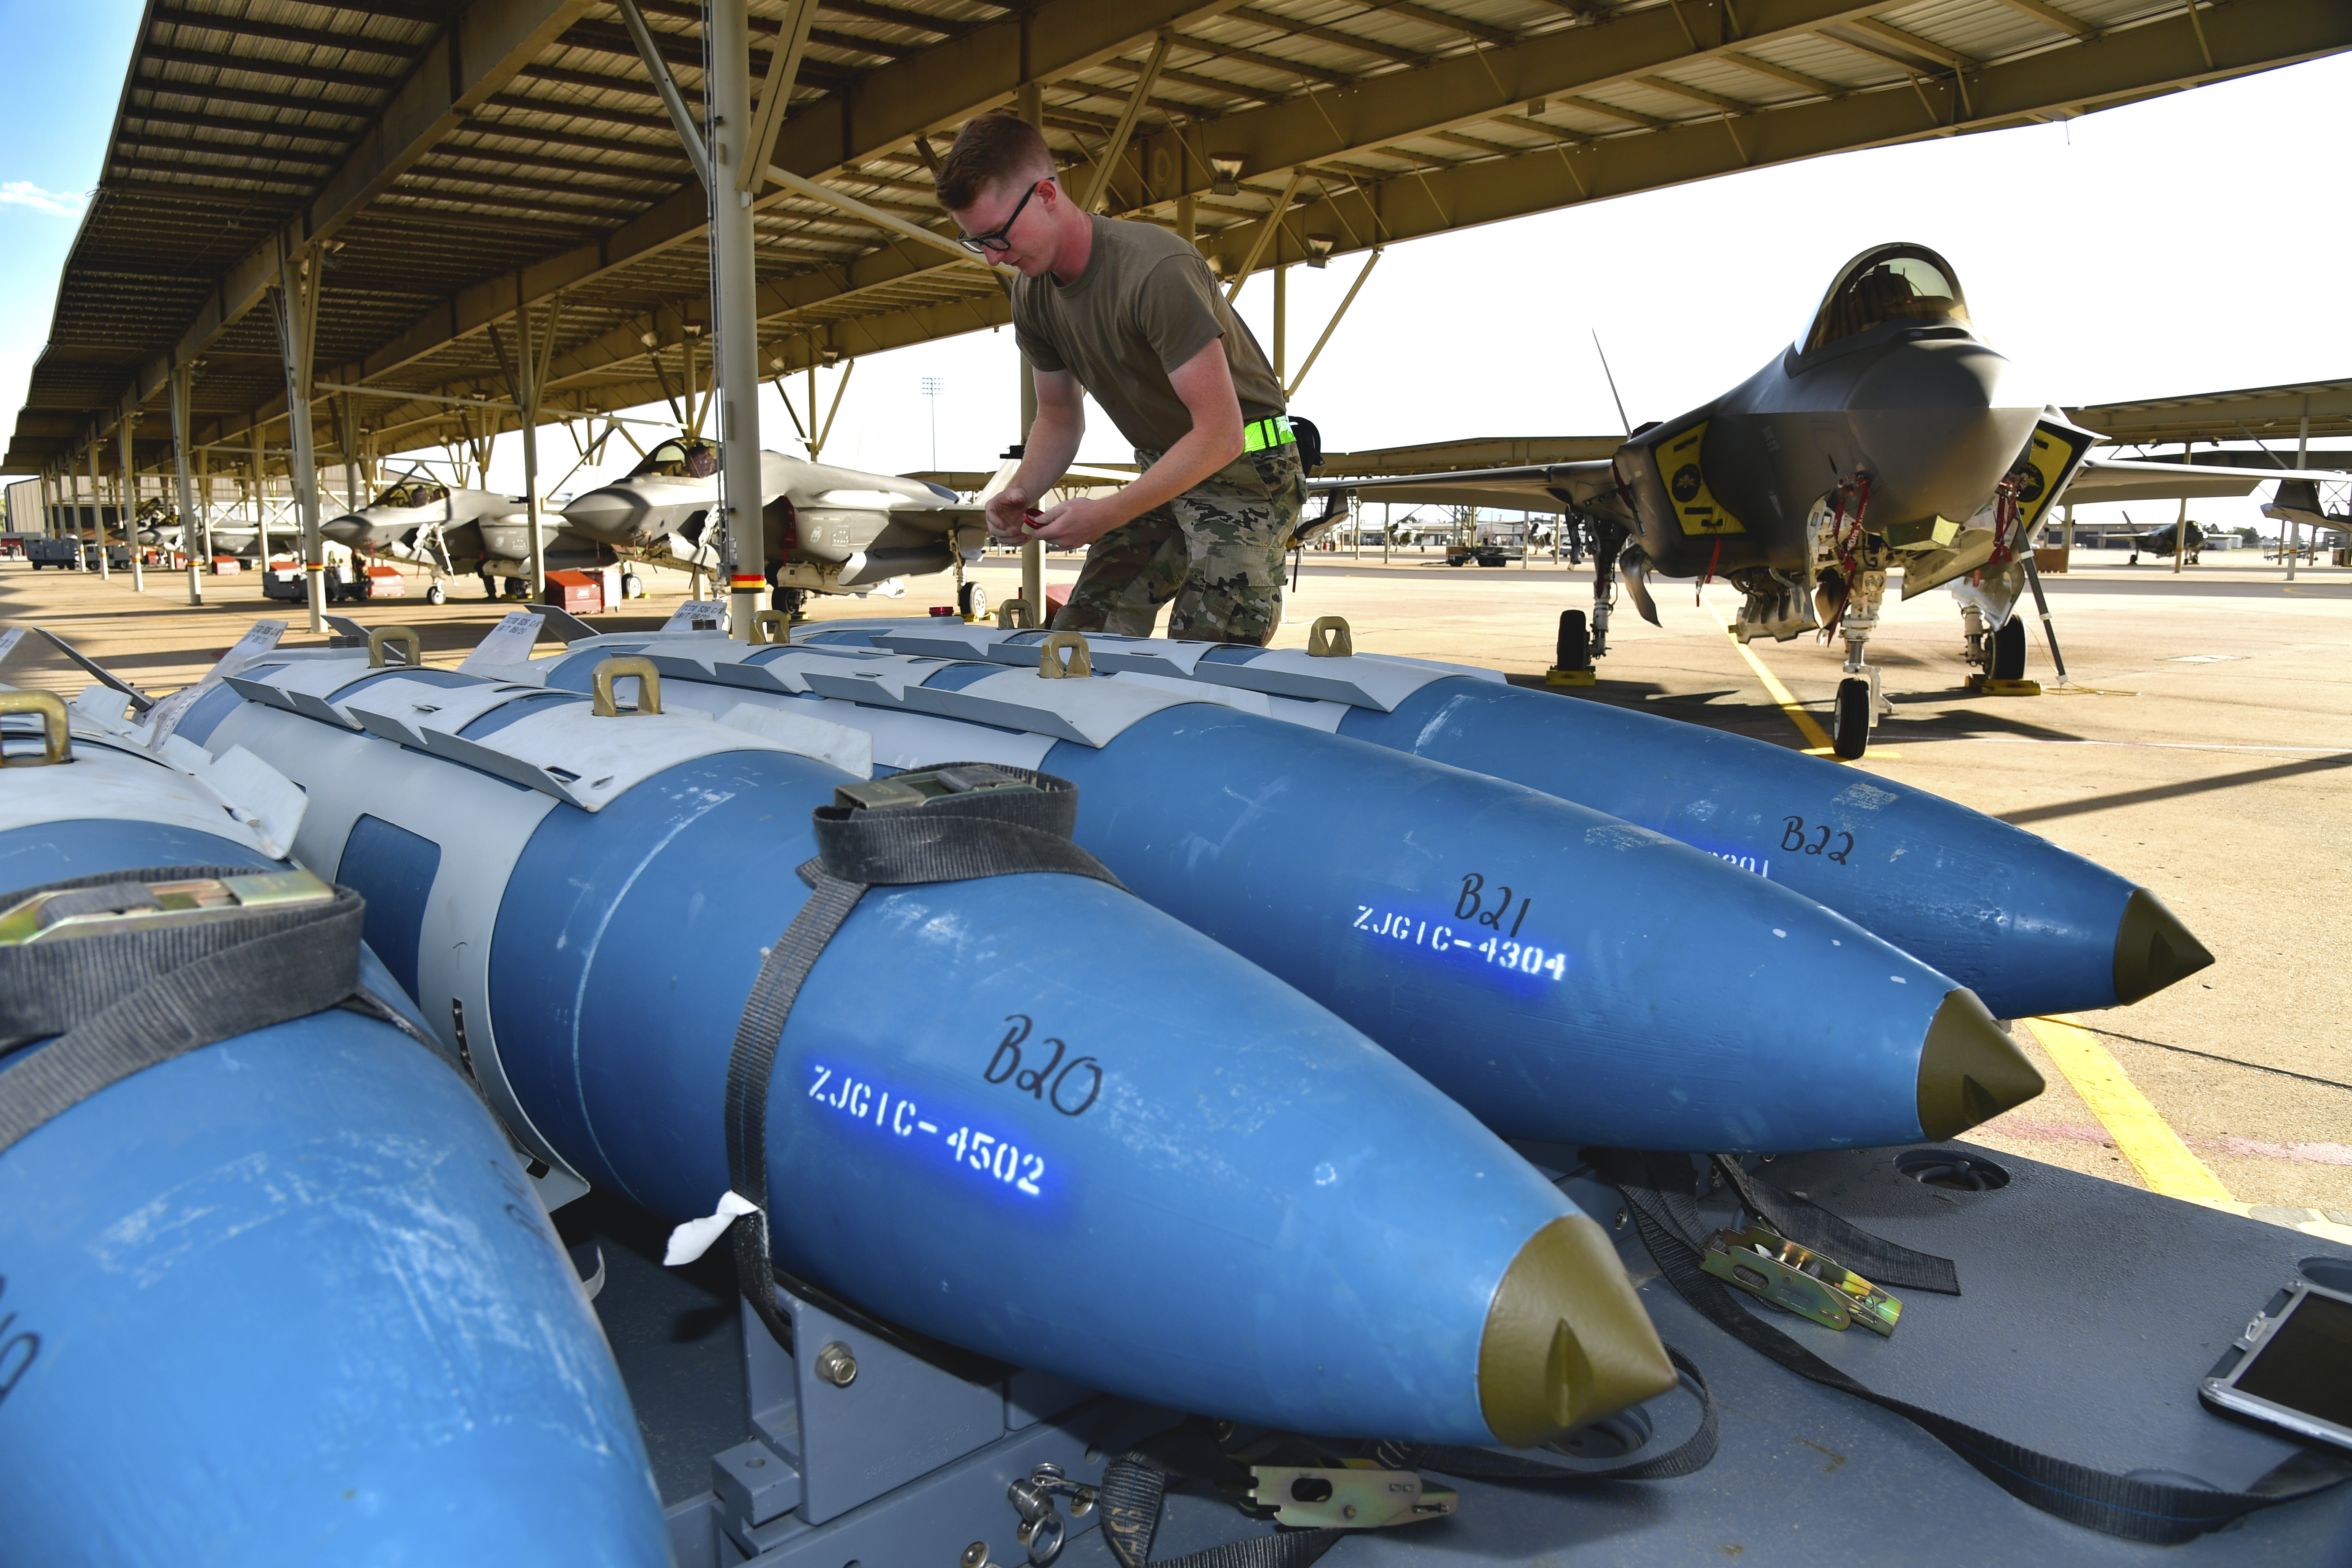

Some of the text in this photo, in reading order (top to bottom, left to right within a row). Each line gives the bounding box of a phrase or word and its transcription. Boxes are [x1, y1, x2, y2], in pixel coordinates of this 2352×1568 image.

[1780, 816, 1854, 866] B22
[1455, 873, 1531, 938] B21
[984, 1014, 1103, 1116] B20
